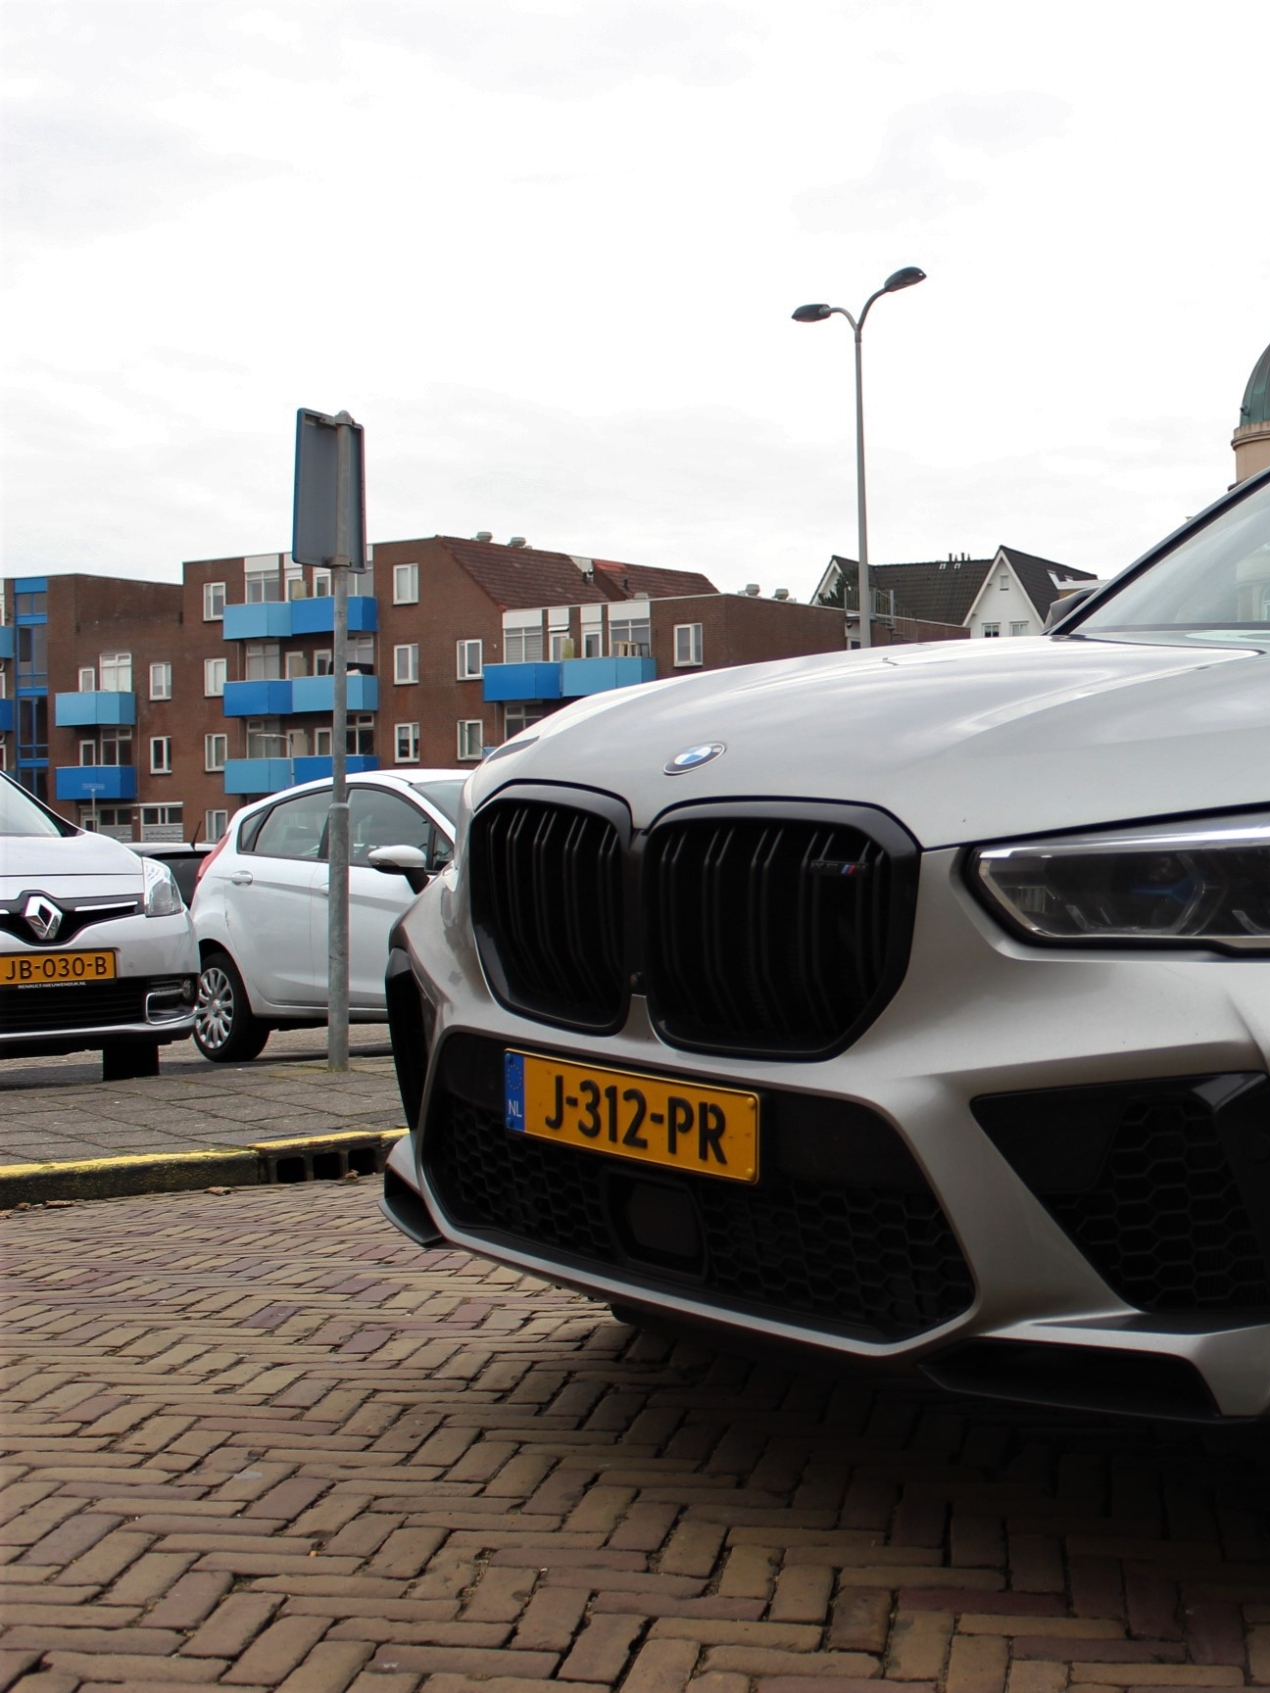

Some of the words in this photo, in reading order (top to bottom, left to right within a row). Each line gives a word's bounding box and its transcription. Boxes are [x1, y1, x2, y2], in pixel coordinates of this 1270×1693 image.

[5, 956, 107, 980] JB-030-B
[508, 1098, 523, 1118] NL
[545, 1074, 728, 1165] J-312-PR
